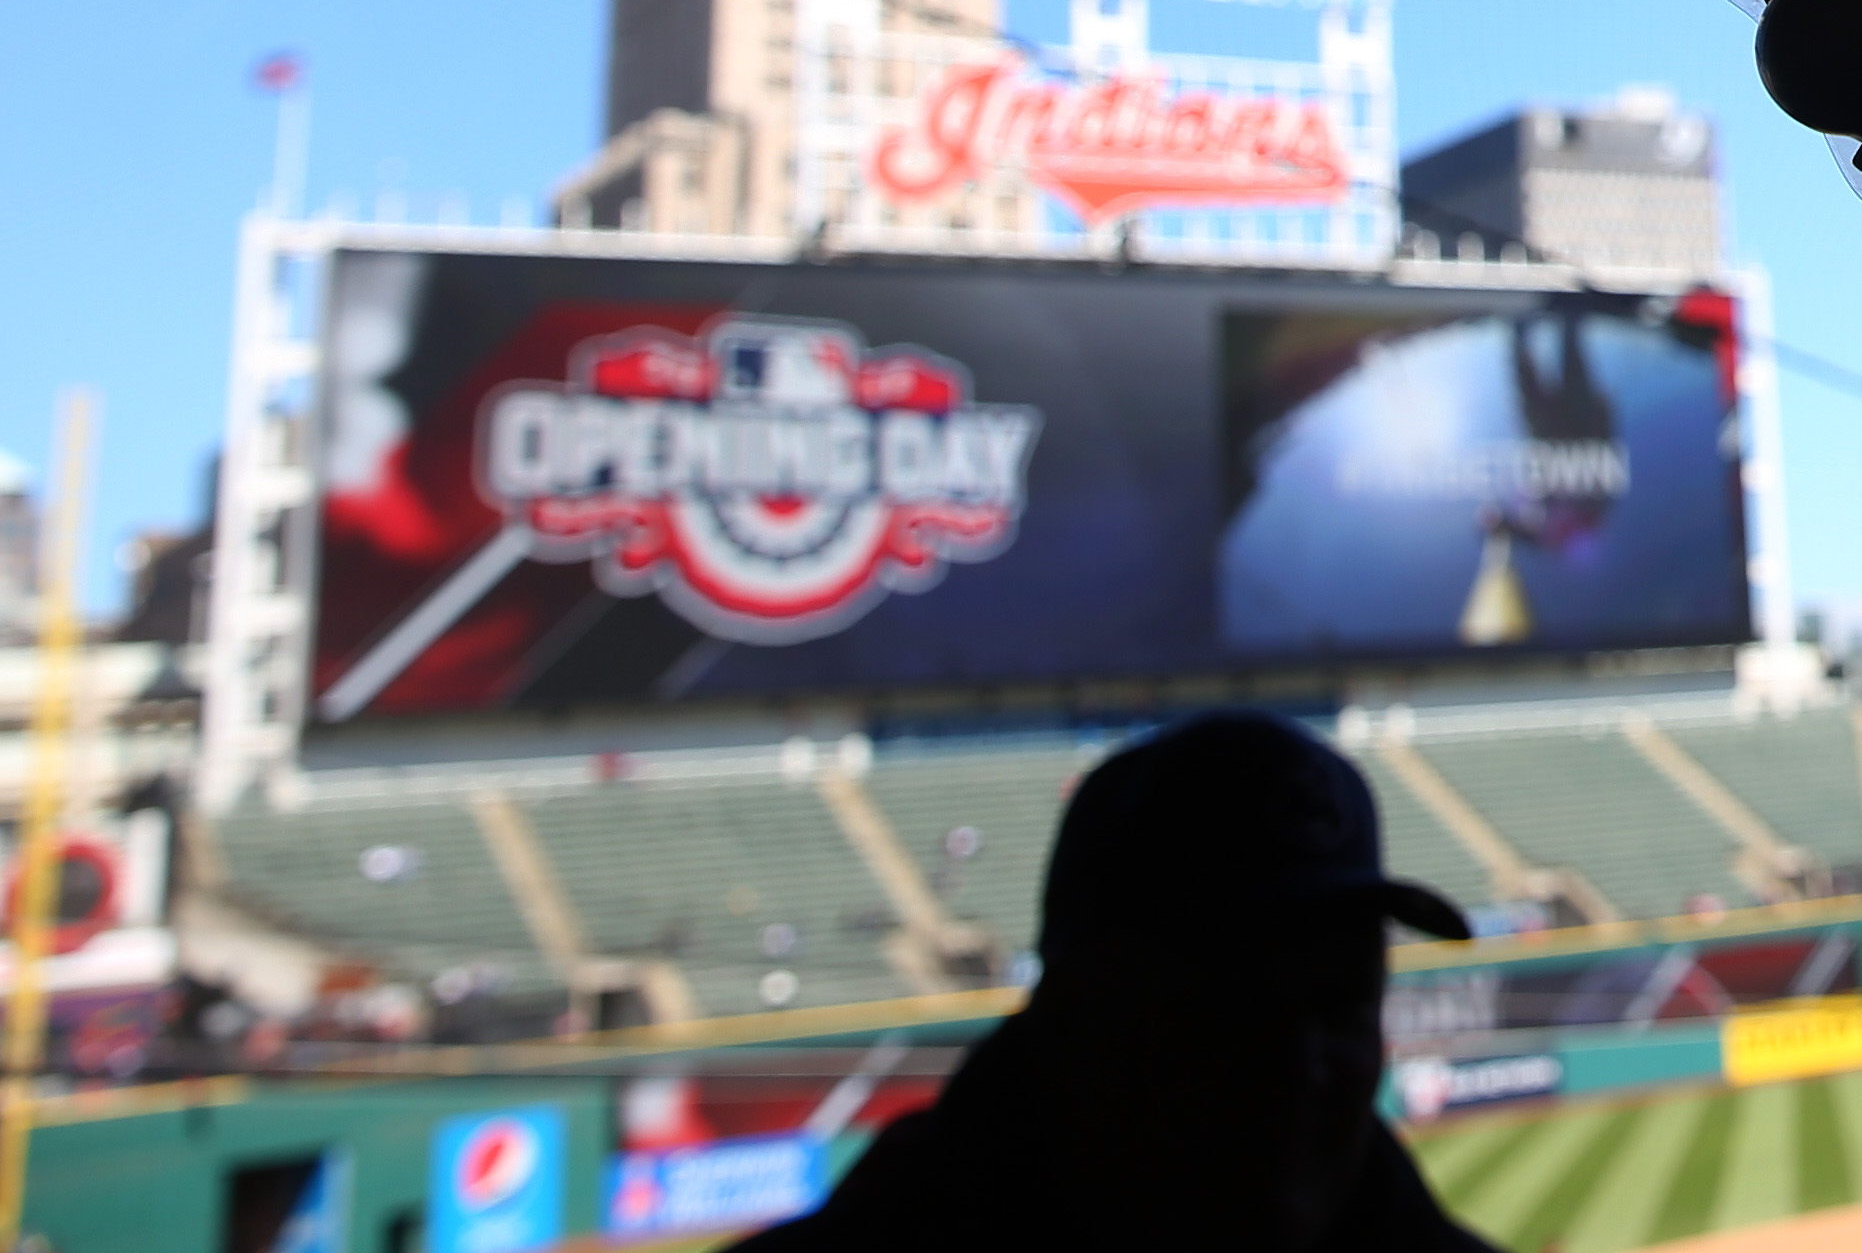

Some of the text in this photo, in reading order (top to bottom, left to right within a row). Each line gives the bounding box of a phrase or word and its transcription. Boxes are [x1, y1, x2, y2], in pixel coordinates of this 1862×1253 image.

[865, 52, 1345, 203] Indians
[490, 392, 1038, 506] OPENING DAY
